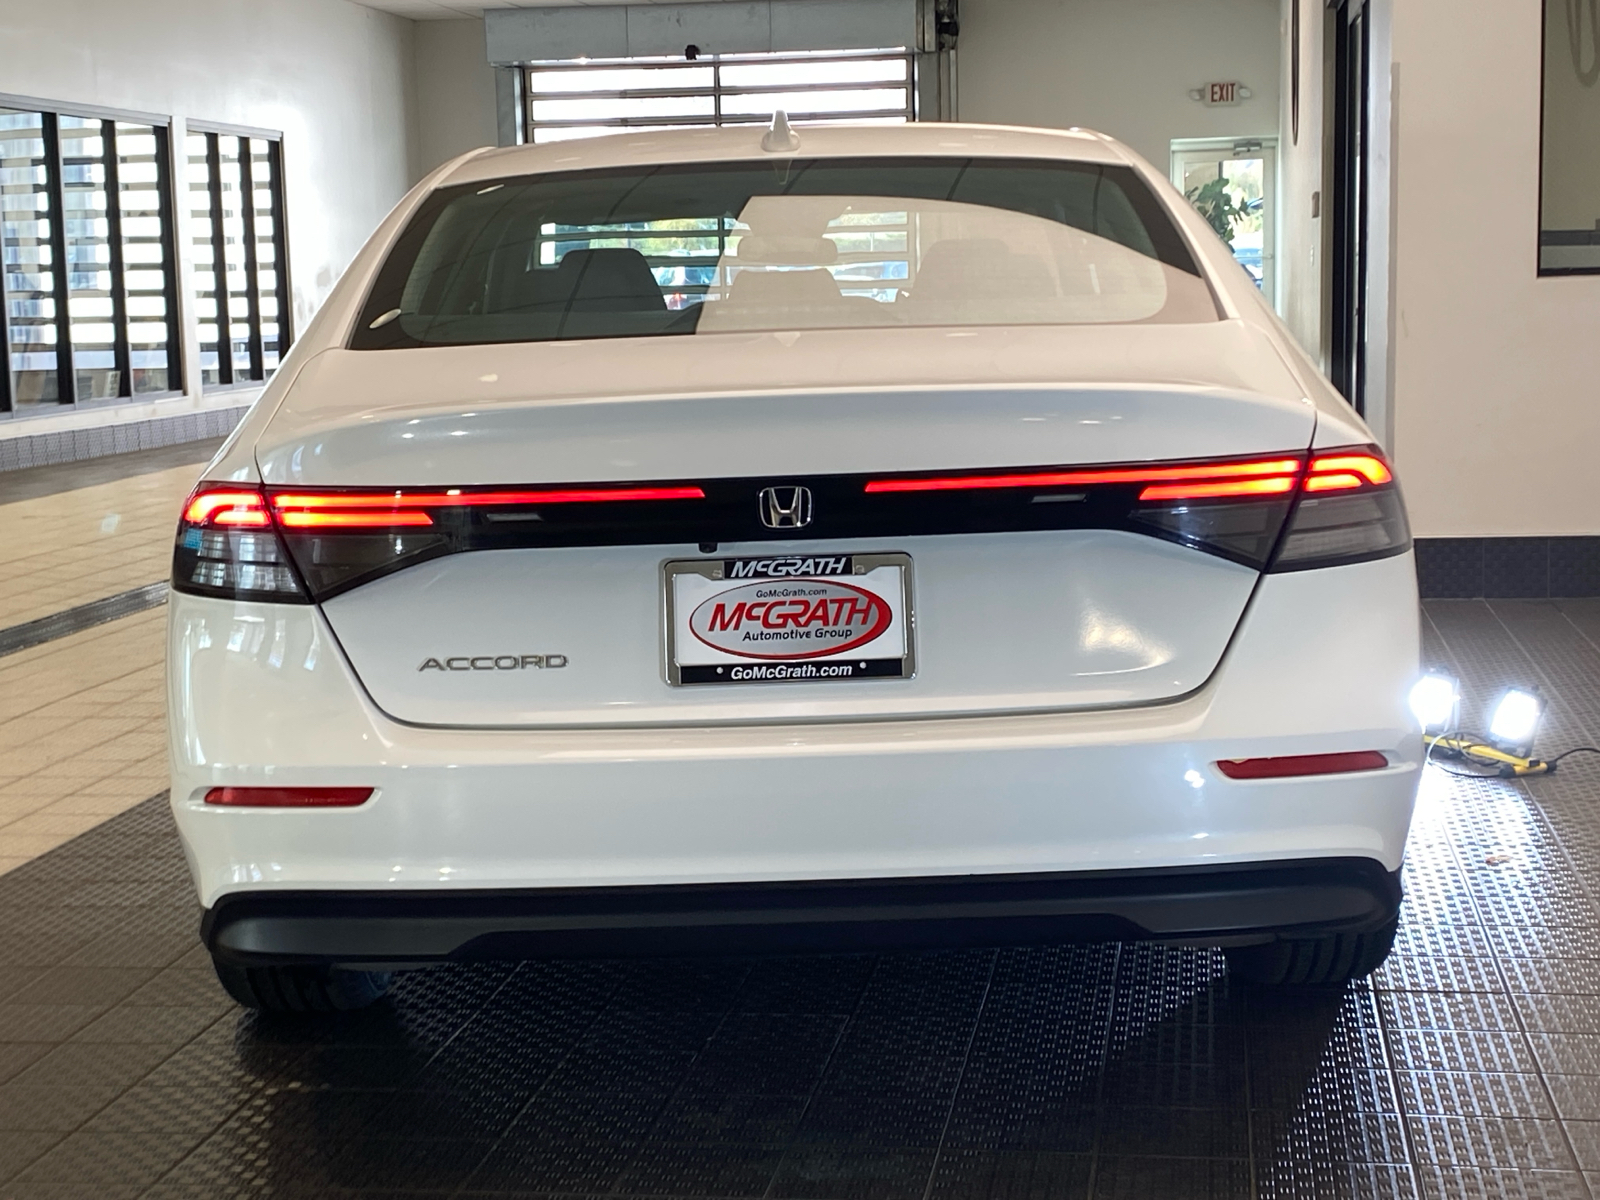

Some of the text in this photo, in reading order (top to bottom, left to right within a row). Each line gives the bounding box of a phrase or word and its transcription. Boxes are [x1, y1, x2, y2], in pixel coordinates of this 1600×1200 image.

[1210, 82, 1236, 102] EXIT
[756, 588, 827, 599] GoMcGrath.com
[742, 628, 853, 642] Automotive Group
[417, 654, 569, 672] ACCORD
[730, 664, 853, 680] GoMcGrath.com
